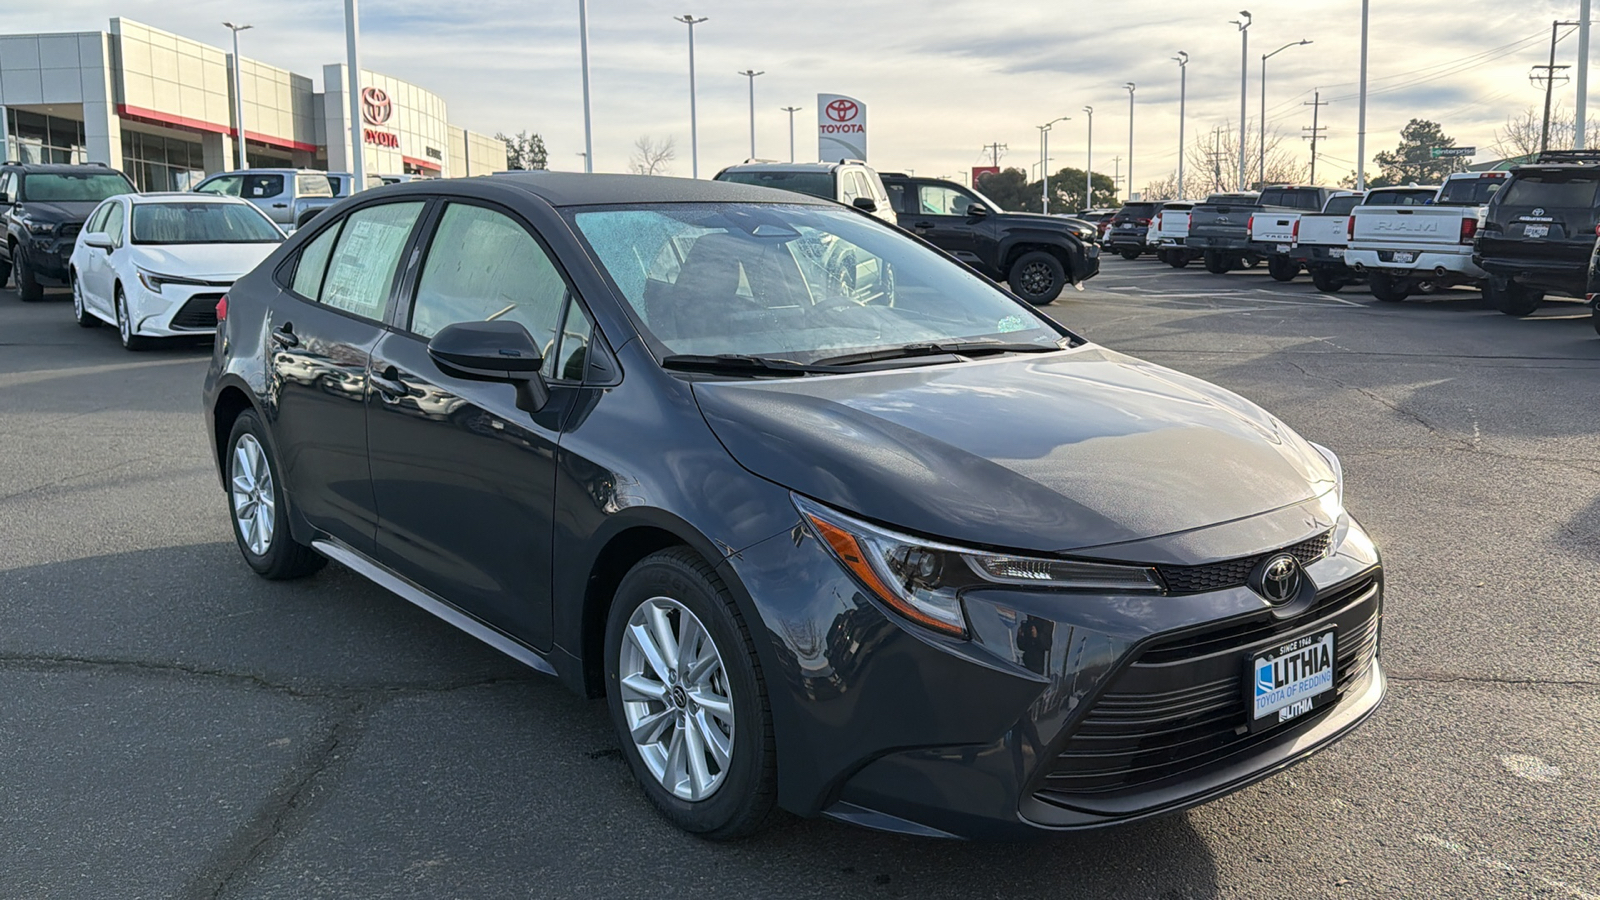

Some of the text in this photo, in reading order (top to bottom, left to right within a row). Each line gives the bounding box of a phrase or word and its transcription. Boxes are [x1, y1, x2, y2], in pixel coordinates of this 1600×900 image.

[364, 128, 399, 149] OYOTA
[820, 124, 865, 133] TOYOTA
[1373, 221, 1438, 232] RAM
[1279, 636, 1311, 655] SINCE 1946
[1274, 643, 1331, 689] LITHIA
[1256, 670, 1331, 710] TOYOTA OF REDDING
[1287, 697, 1313, 719] LITHIA
